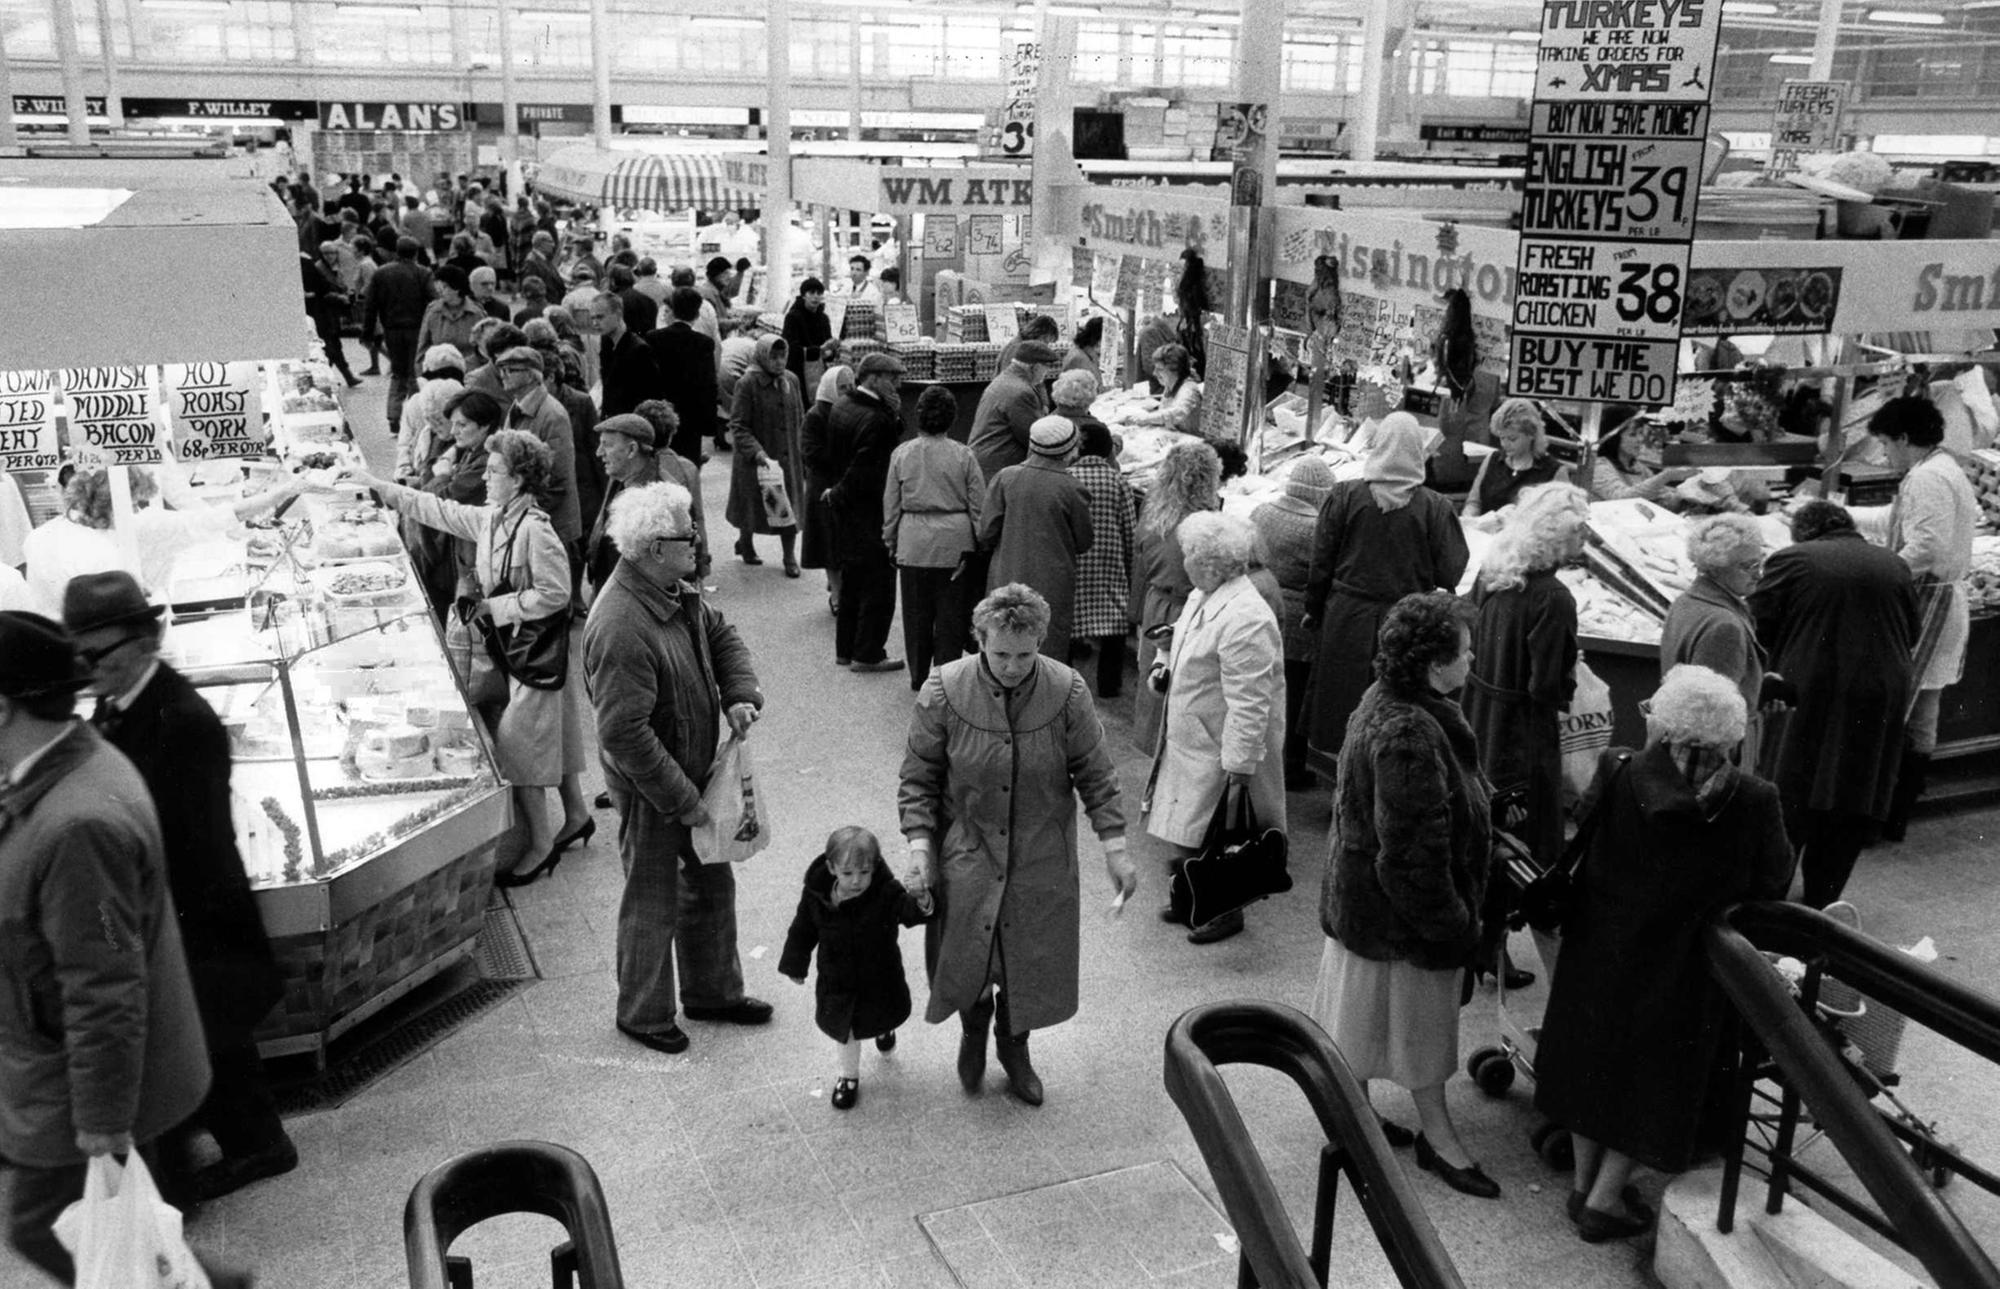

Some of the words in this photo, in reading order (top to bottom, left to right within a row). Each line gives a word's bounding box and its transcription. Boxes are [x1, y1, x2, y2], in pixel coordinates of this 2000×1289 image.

[1545, 0, 1703, 29] TURKEYS
[1583, 30, 1600, 45] WE
[1608, 30, 1634, 45] ARE
[1642, 30, 1670, 45] NOW
[1541, 47, 1589, 62] TAKING
[1597, 48, 1649, 62] ORDERS
[1656, 48, 1684, 62] FOR
[1580, 63, 1671, 92] XMAS
[188, 101, 271, 115] F.WILLEY
[327, 103, 457, 130] ALAN'S
[523, 106, 563, 120] PRIVATE
[1548, 103, 1577, 134] BUY
[1578, 104, 1606, 135] NOW
[1611, 105, 1649, 136] SAVE
[1652, 105, 1704, 136] MONEY
[1527, 142, 1628, 186] ENGLISH
[1631, 143, 1657, 162] FROM
[882, 177, 953, 205] WM
[963, 178, 1032, 206] ATK
[1627, 165, 1688, 223] 39
[1524, 188, 1626, 232] TURKEYS
[1525, 244, 1595, 271] FRESH
[1518, 271, 1611, 300] ROASTING
[1616, 262, 1681, 323] 38
[1516, 301, 1597, 328] CHICKEN
[1519, 337, 1587, 367] BUY
[1592, 341, 1651, 372] THE
[64, 367, 146, 391] DANISH
[182, 361, 230, 386] HOT
[1516, 366, 1583, 396] BEST
[1590, 370, 1623, 398] WE
[1629, 373, 1666, 400] DO
[73, 394, 149, 419] MIDDLE
[180, 389, 249, 415] ROAST
[83, 423, 155, 446] BACON
[189, 417, 248, 438] PORK
[7, 455, 34, 468] PER
[115, 449, 144, 462] PER
[210, 442, 238, 455] PER
